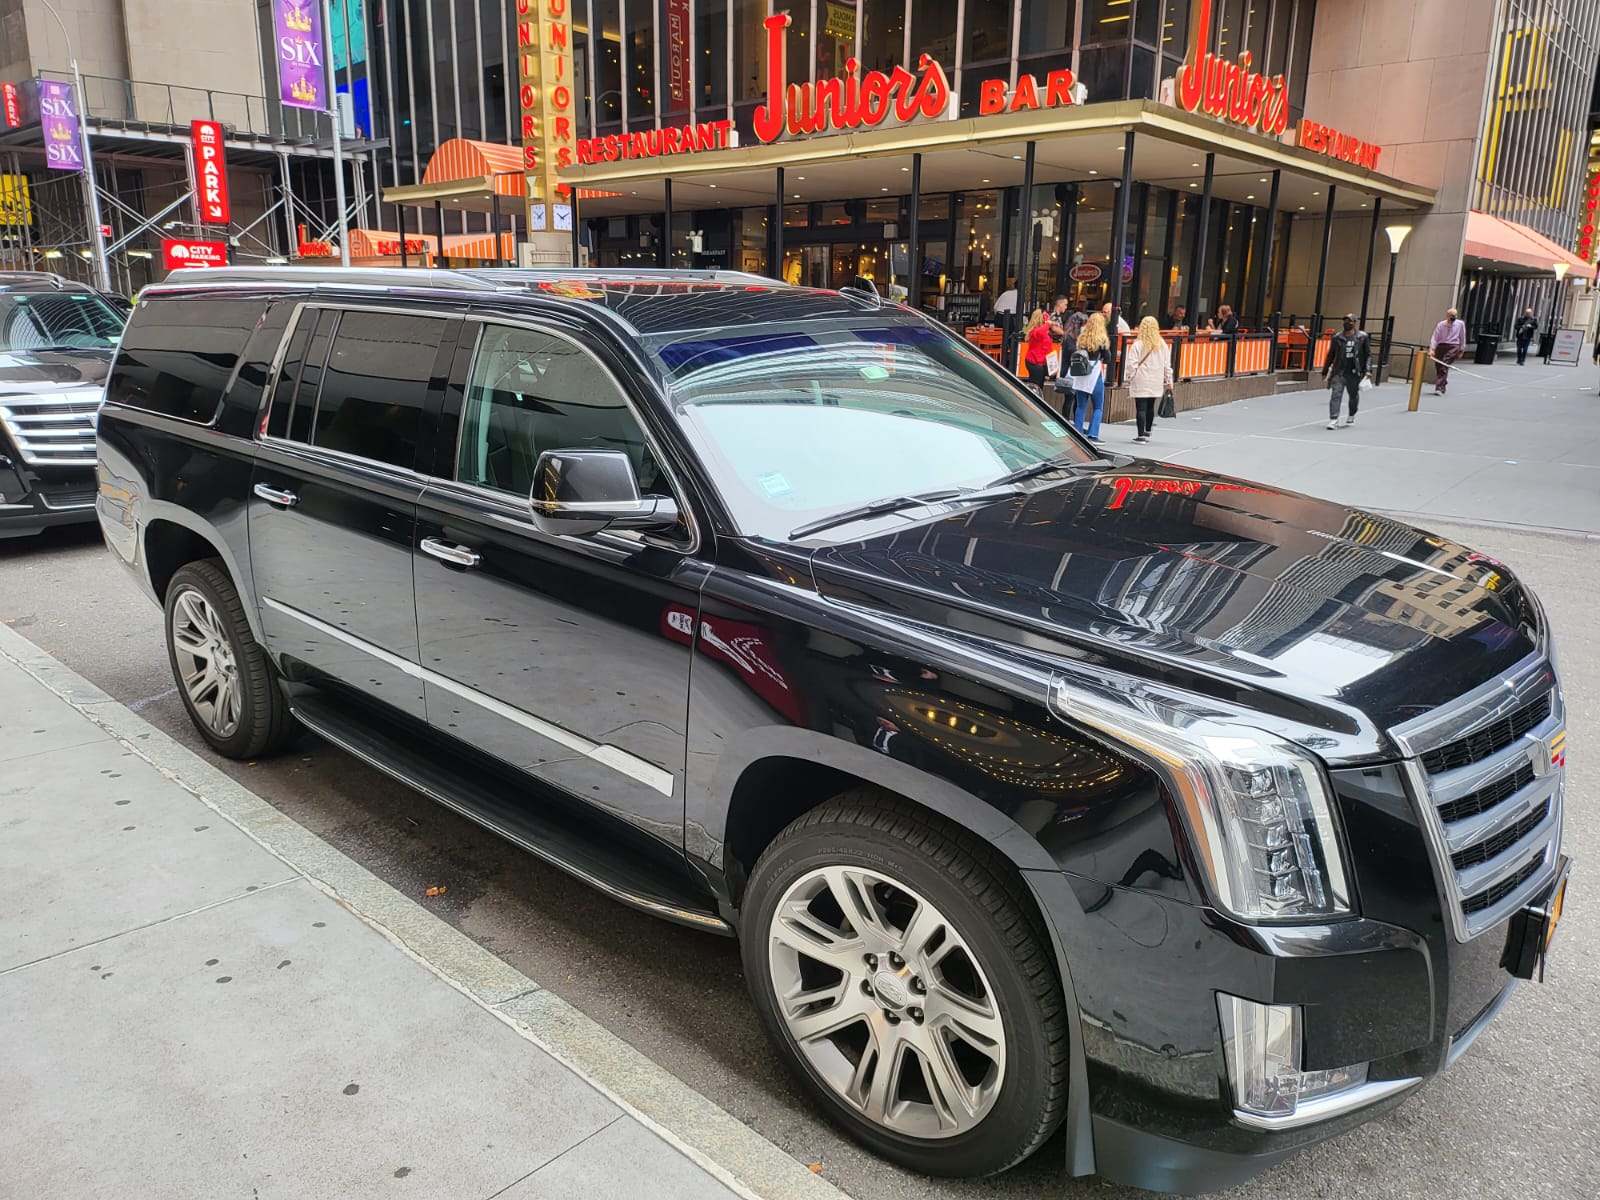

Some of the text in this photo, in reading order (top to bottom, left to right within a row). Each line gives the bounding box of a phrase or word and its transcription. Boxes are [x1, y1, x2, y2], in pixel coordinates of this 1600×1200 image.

[754, 14, 950, 142] Junior's
[979, 68, 1076, 115] BAR
[577, 119, 733, 164] RESTAURANT
[1299, 119, 1381, 170] RESTAURANT
[202, 145, 220, 203] PARK
[190, 246, 213, 255] CITY
[191, 253, 221, 261] PARKING
